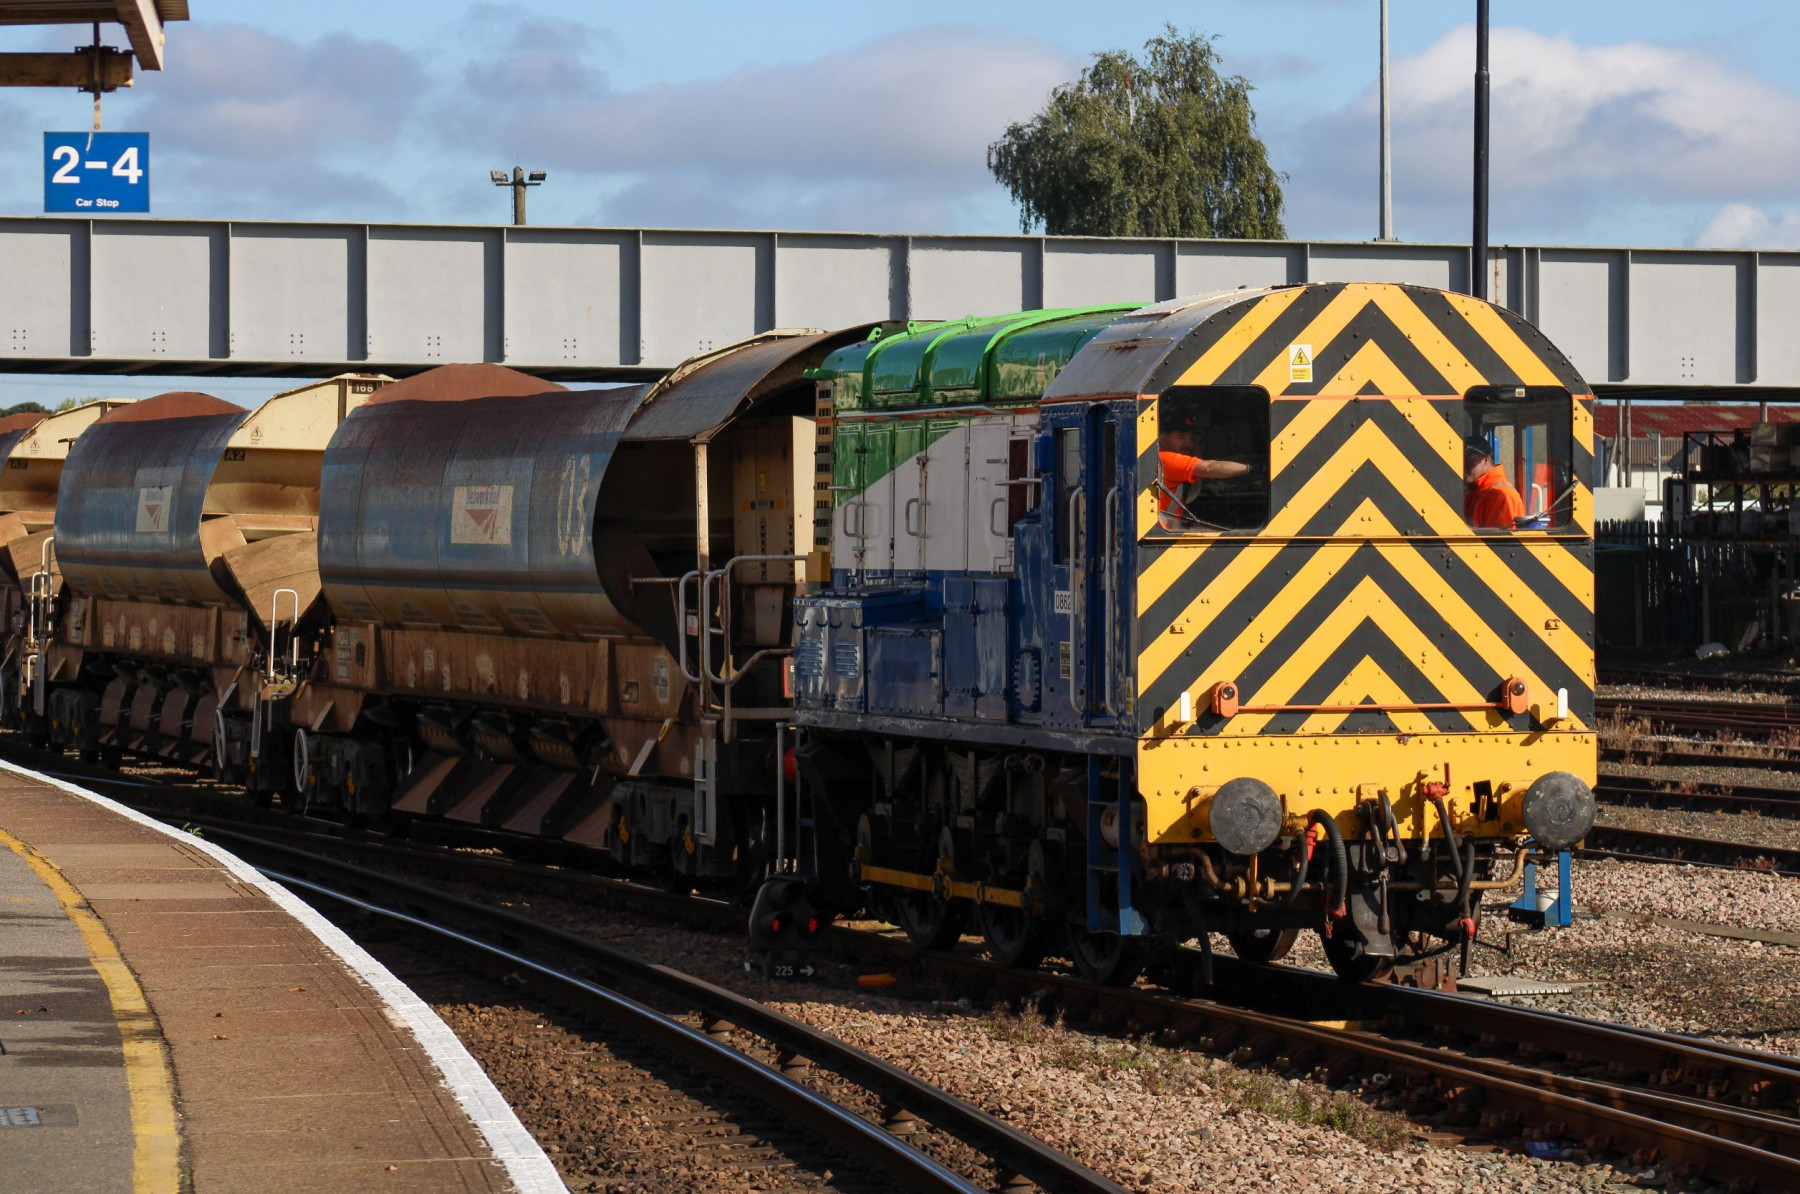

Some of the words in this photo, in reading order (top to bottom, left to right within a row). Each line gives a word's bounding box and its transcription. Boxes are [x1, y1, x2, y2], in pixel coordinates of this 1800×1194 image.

[52, 146, 143, 184] 2-4
[75, 198, 94, 207] Car
[96, 198, 119, 208] Stop
[225, 449, 244, 461] A2
[775, 965, 793, 976] 225
